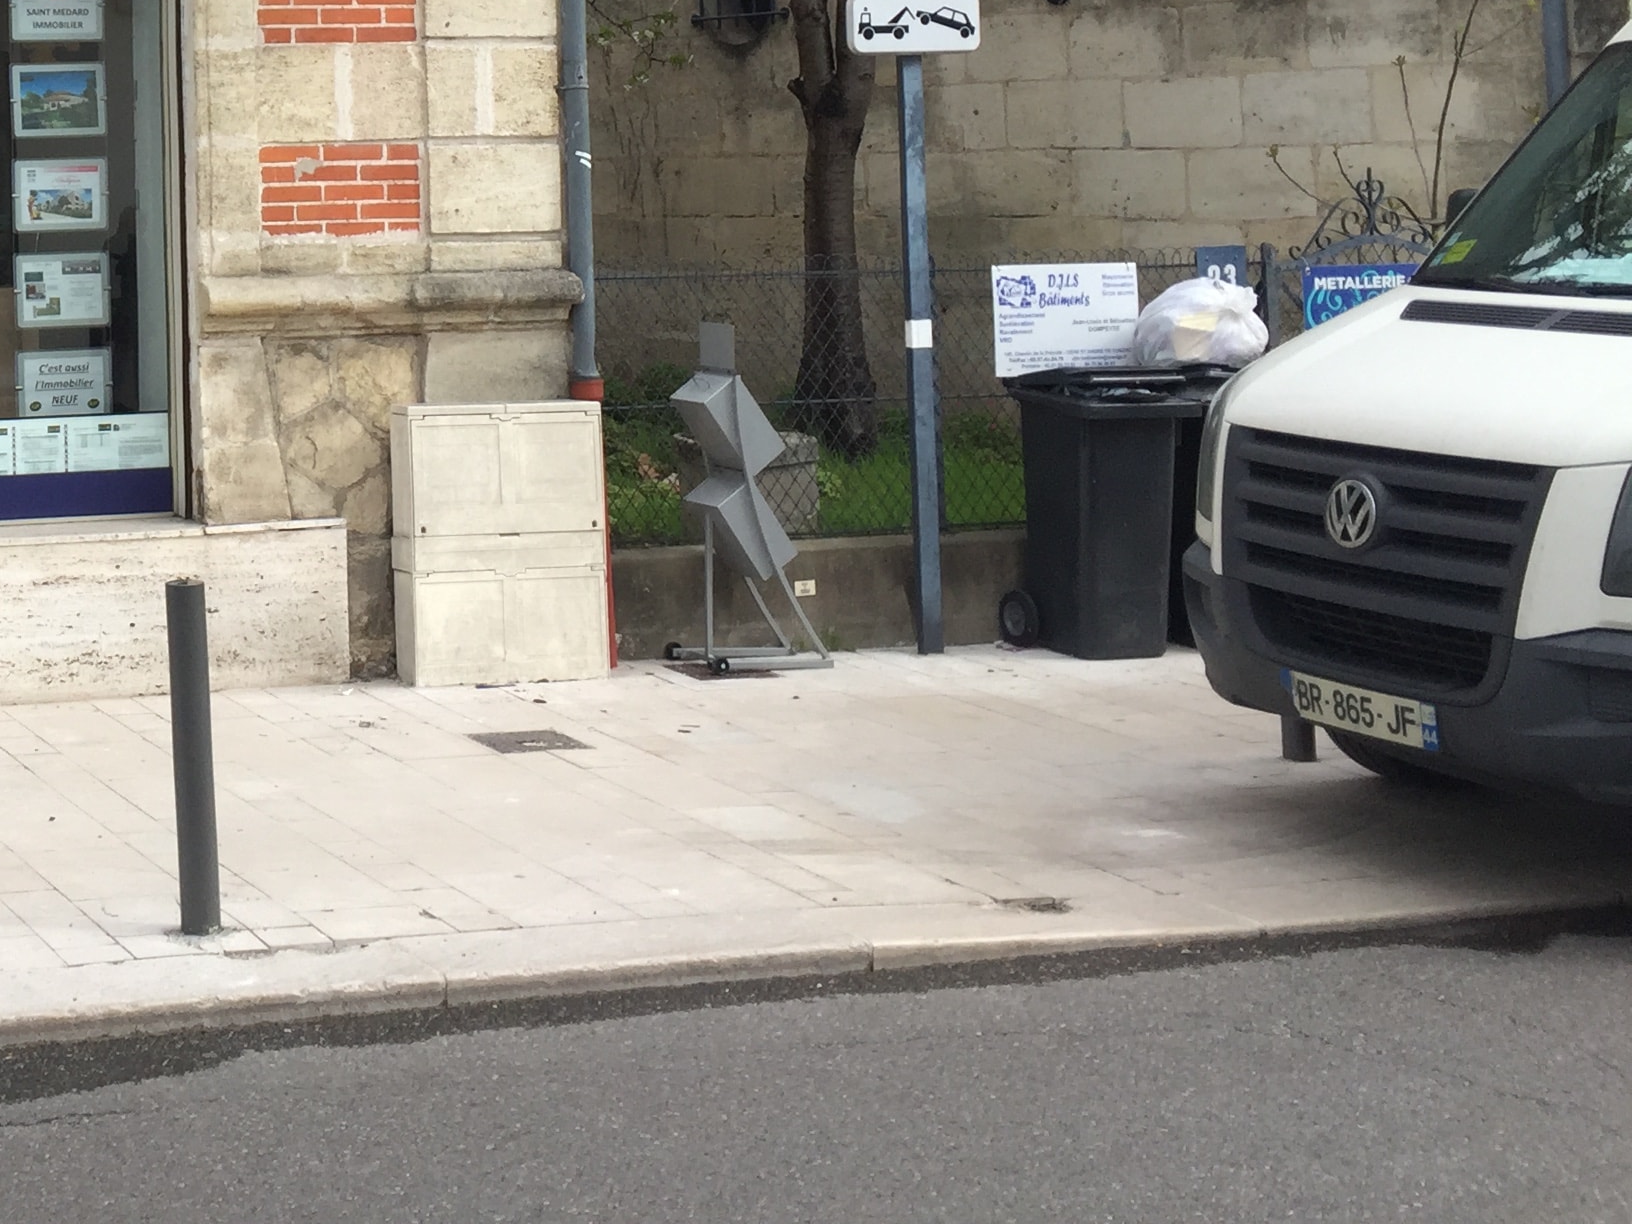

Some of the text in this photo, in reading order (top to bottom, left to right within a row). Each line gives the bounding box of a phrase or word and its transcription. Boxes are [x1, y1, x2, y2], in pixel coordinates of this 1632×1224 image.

[26, 8, 89, 16] SAINT MEDARD
[32, 21, 83, 29] IMMOBILIER
[1314, 274, 1406, 290] METALLERIE
[1038, 292, 1090, 308] Bâtiments
[64, 362, 90, 373] aussi
[52, 394, 79, 405] NEUF
[1423, 728, 1438, 745] 44
